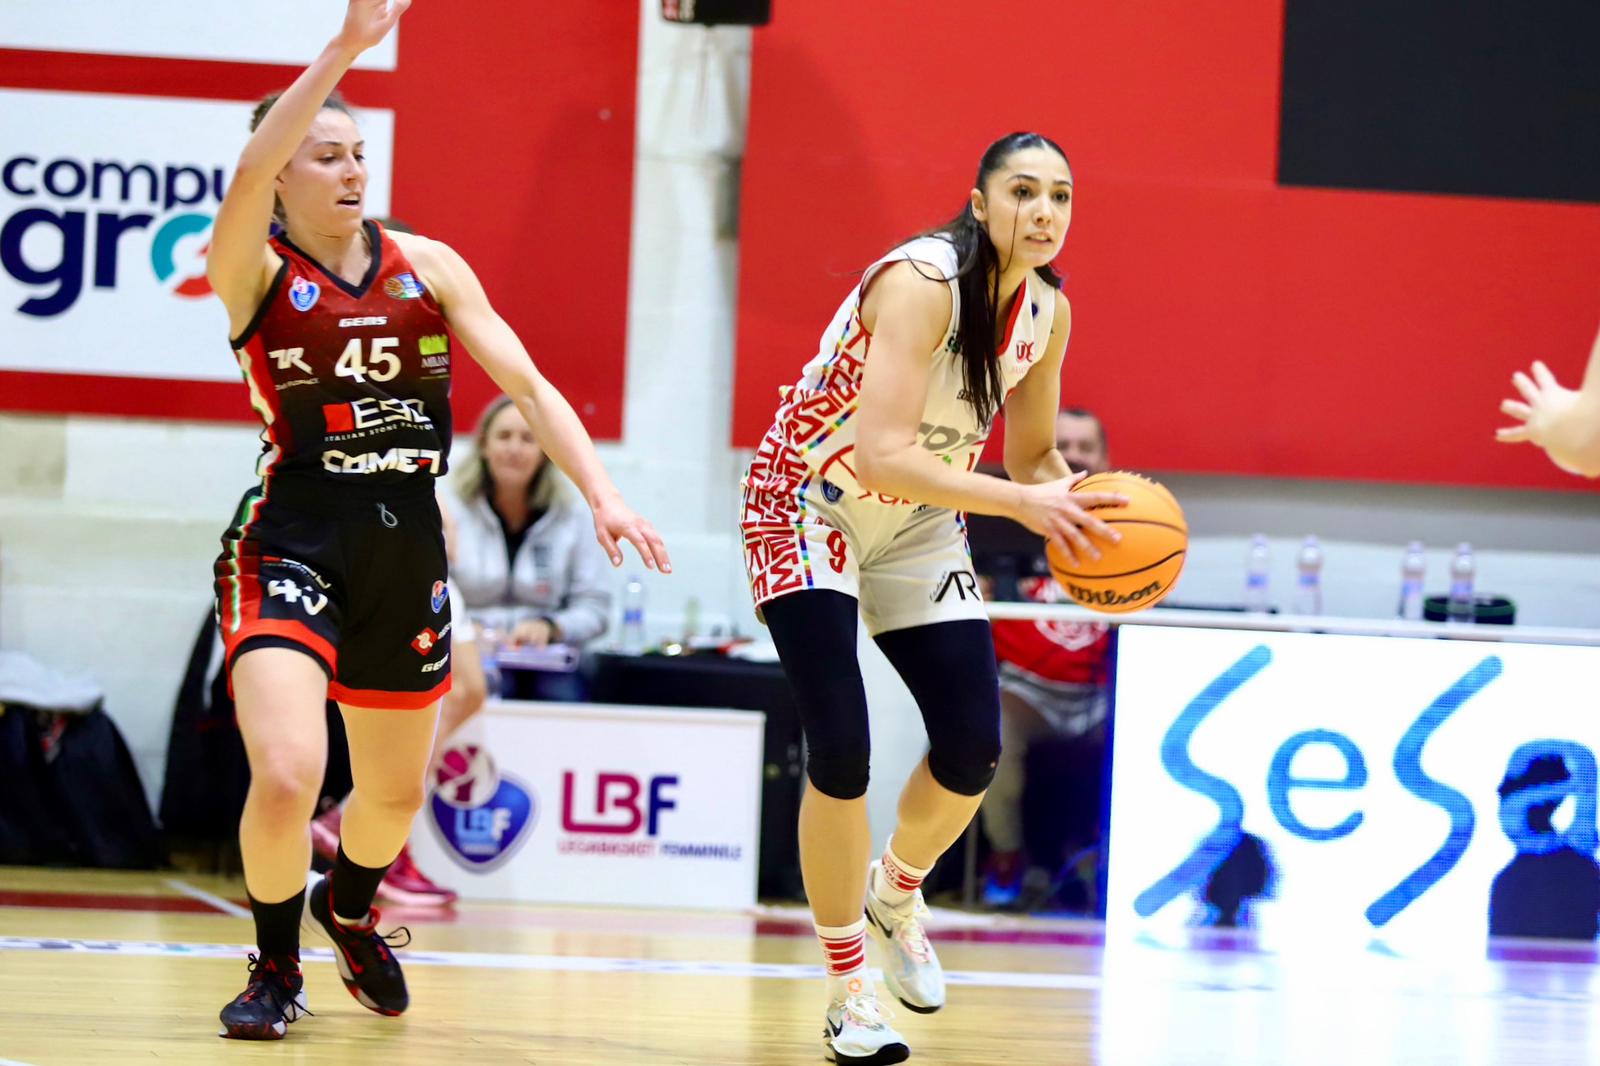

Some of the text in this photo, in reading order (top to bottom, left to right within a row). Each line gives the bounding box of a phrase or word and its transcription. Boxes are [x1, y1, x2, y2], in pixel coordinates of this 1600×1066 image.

[338, 316, 388, 328] GEMS
[335, 337, 401, 383] 45
[325, 421, 434, 442] ITALIAN STONE FACTO
[321, 448, 441, 474] COMET
[826, 530, 847, 574] 9
[1068, 581, 1160, 606] Wilson
[561, 770, 680, 836] LBF
[455, 808, 512, 841] LBF
